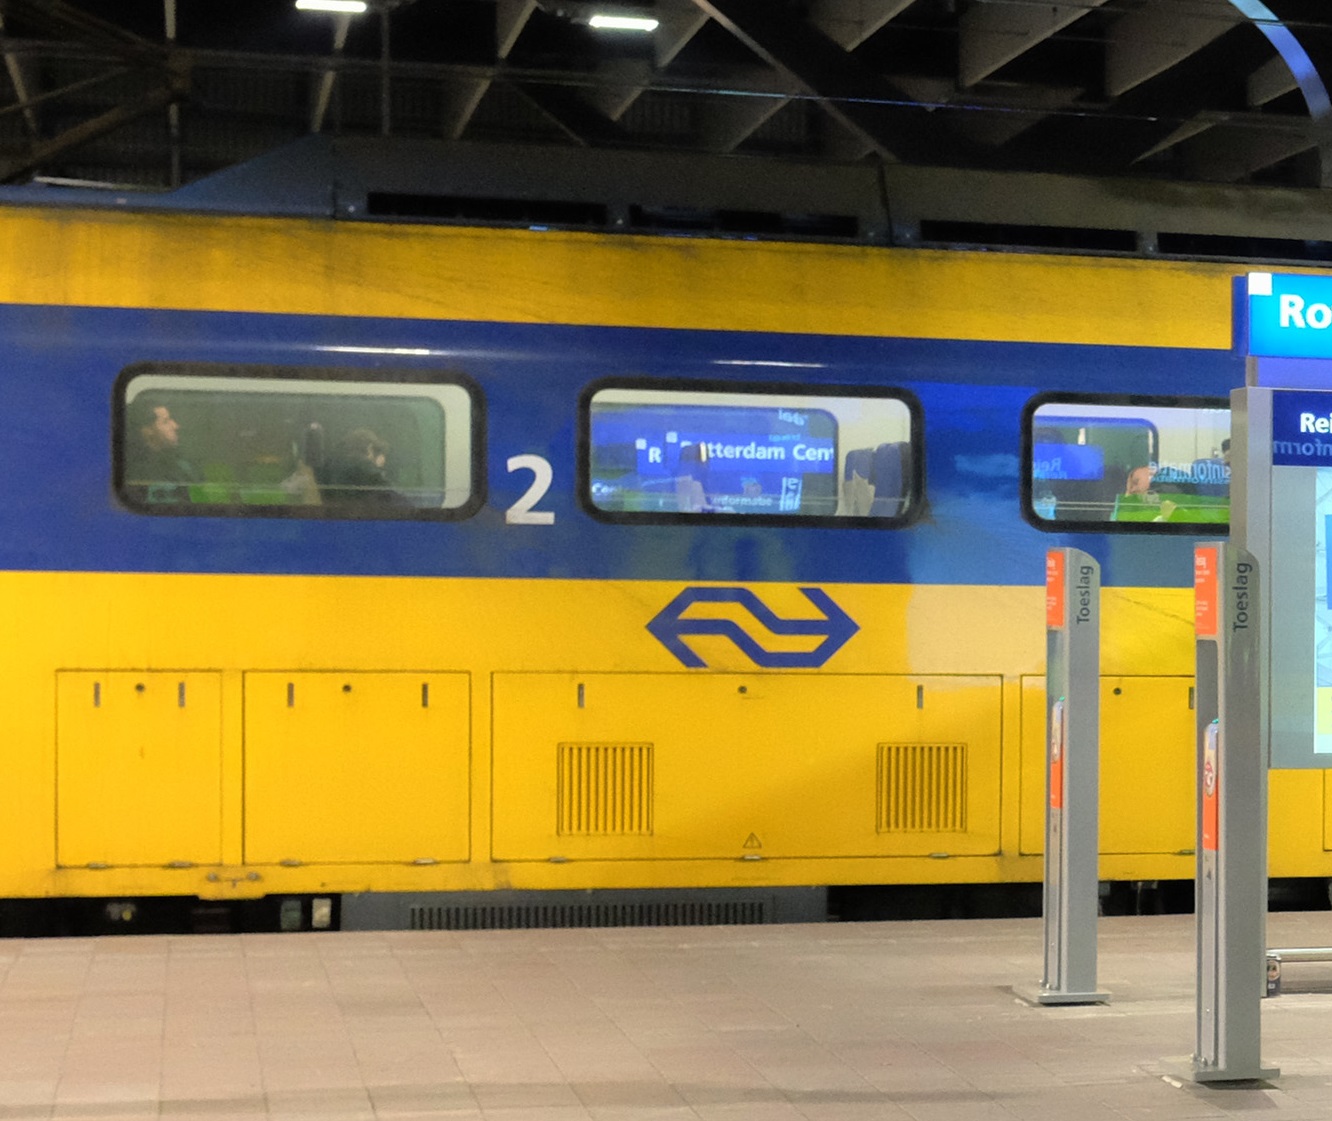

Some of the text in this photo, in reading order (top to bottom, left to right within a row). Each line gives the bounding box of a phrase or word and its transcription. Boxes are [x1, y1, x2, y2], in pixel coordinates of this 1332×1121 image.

[505, 453, 555, 525] 2
[1076, 565, 1095, 625] Toeslag
[1232, 562, 1253, 633] Toeslag
